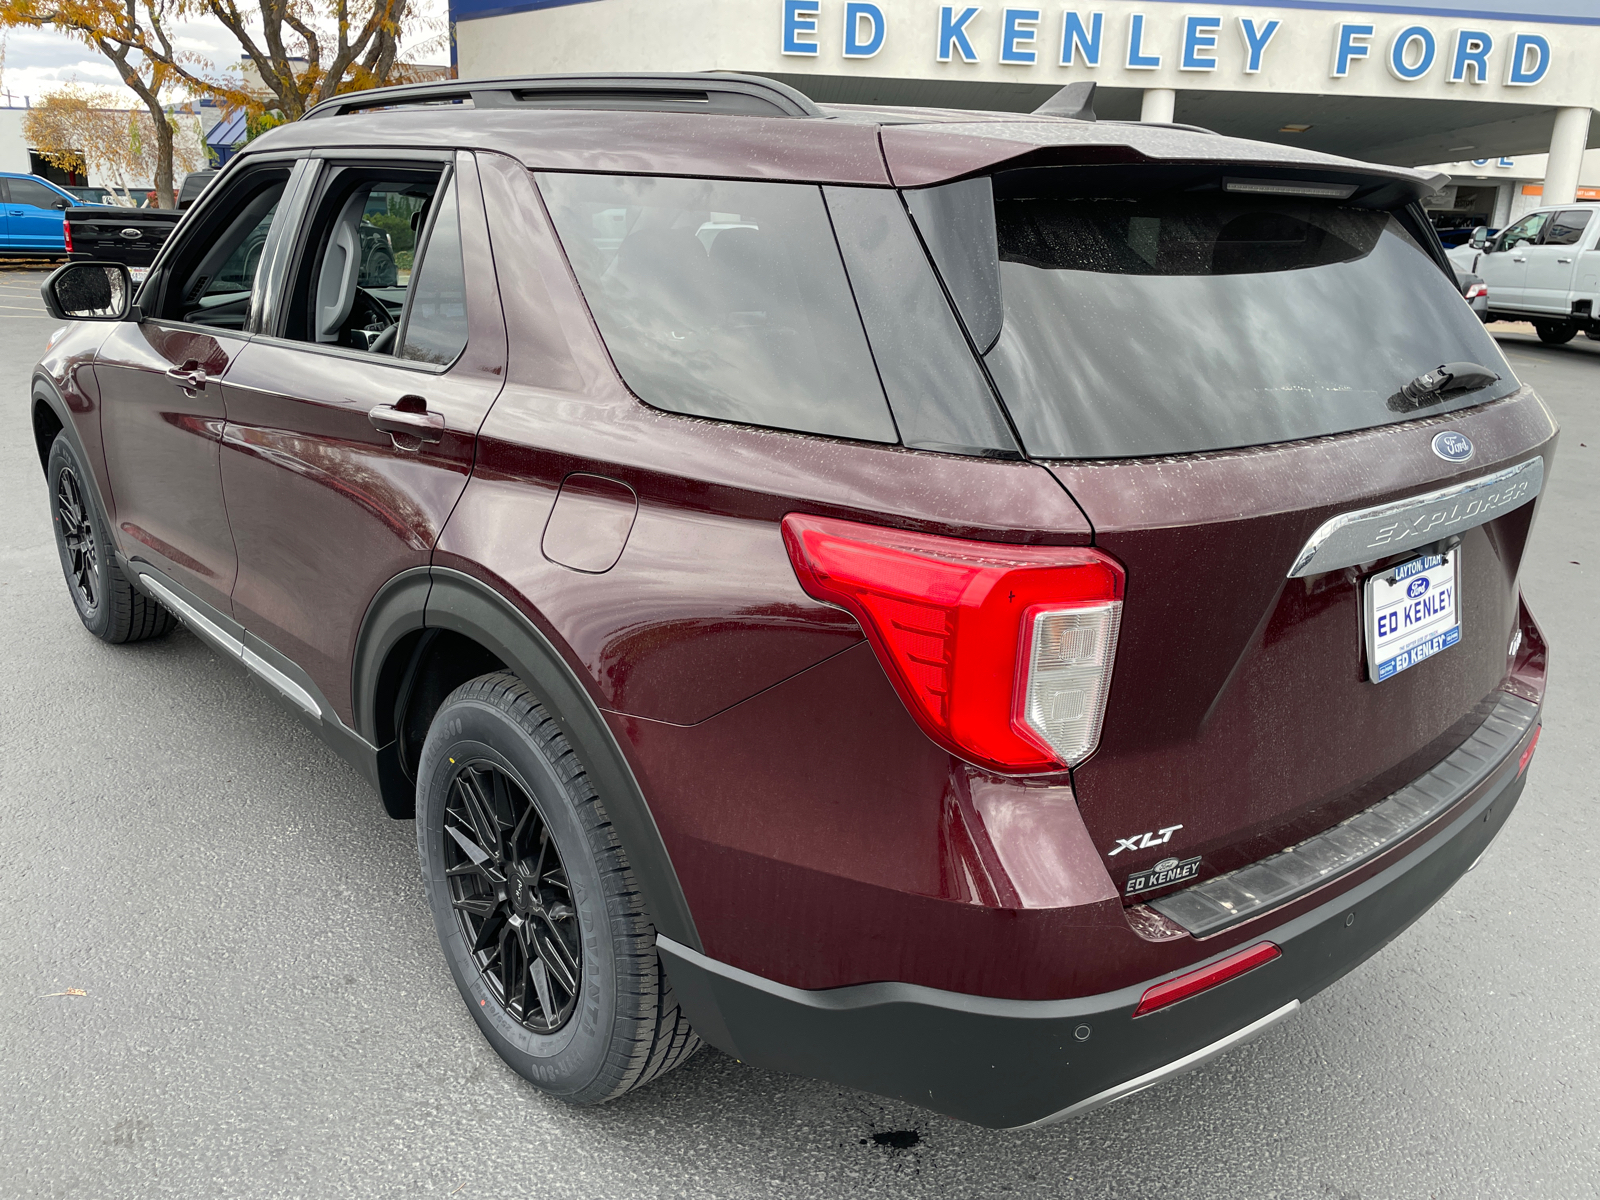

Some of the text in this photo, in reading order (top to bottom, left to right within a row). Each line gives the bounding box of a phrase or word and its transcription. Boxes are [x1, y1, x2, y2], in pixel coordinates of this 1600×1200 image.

[783, 0, 1551, 84] ED KENLEY FORD
[1443, 435, 1470, 456] Ford
[1366, 480, 1529, 549] EXPLORER
[1395, 562, 1423, 581] LAYTON,
[1410, 579, 1427, 598] Ford
[1377, 585, 1453, 638] ED KENLEY
[1395, 652, 1409, 672] ED
[1411, 635, 1444, 664] KENLEY
[1107, 823, 1184, 856] XLT
[1126, 861, 1200, 892] ED KENLEY
